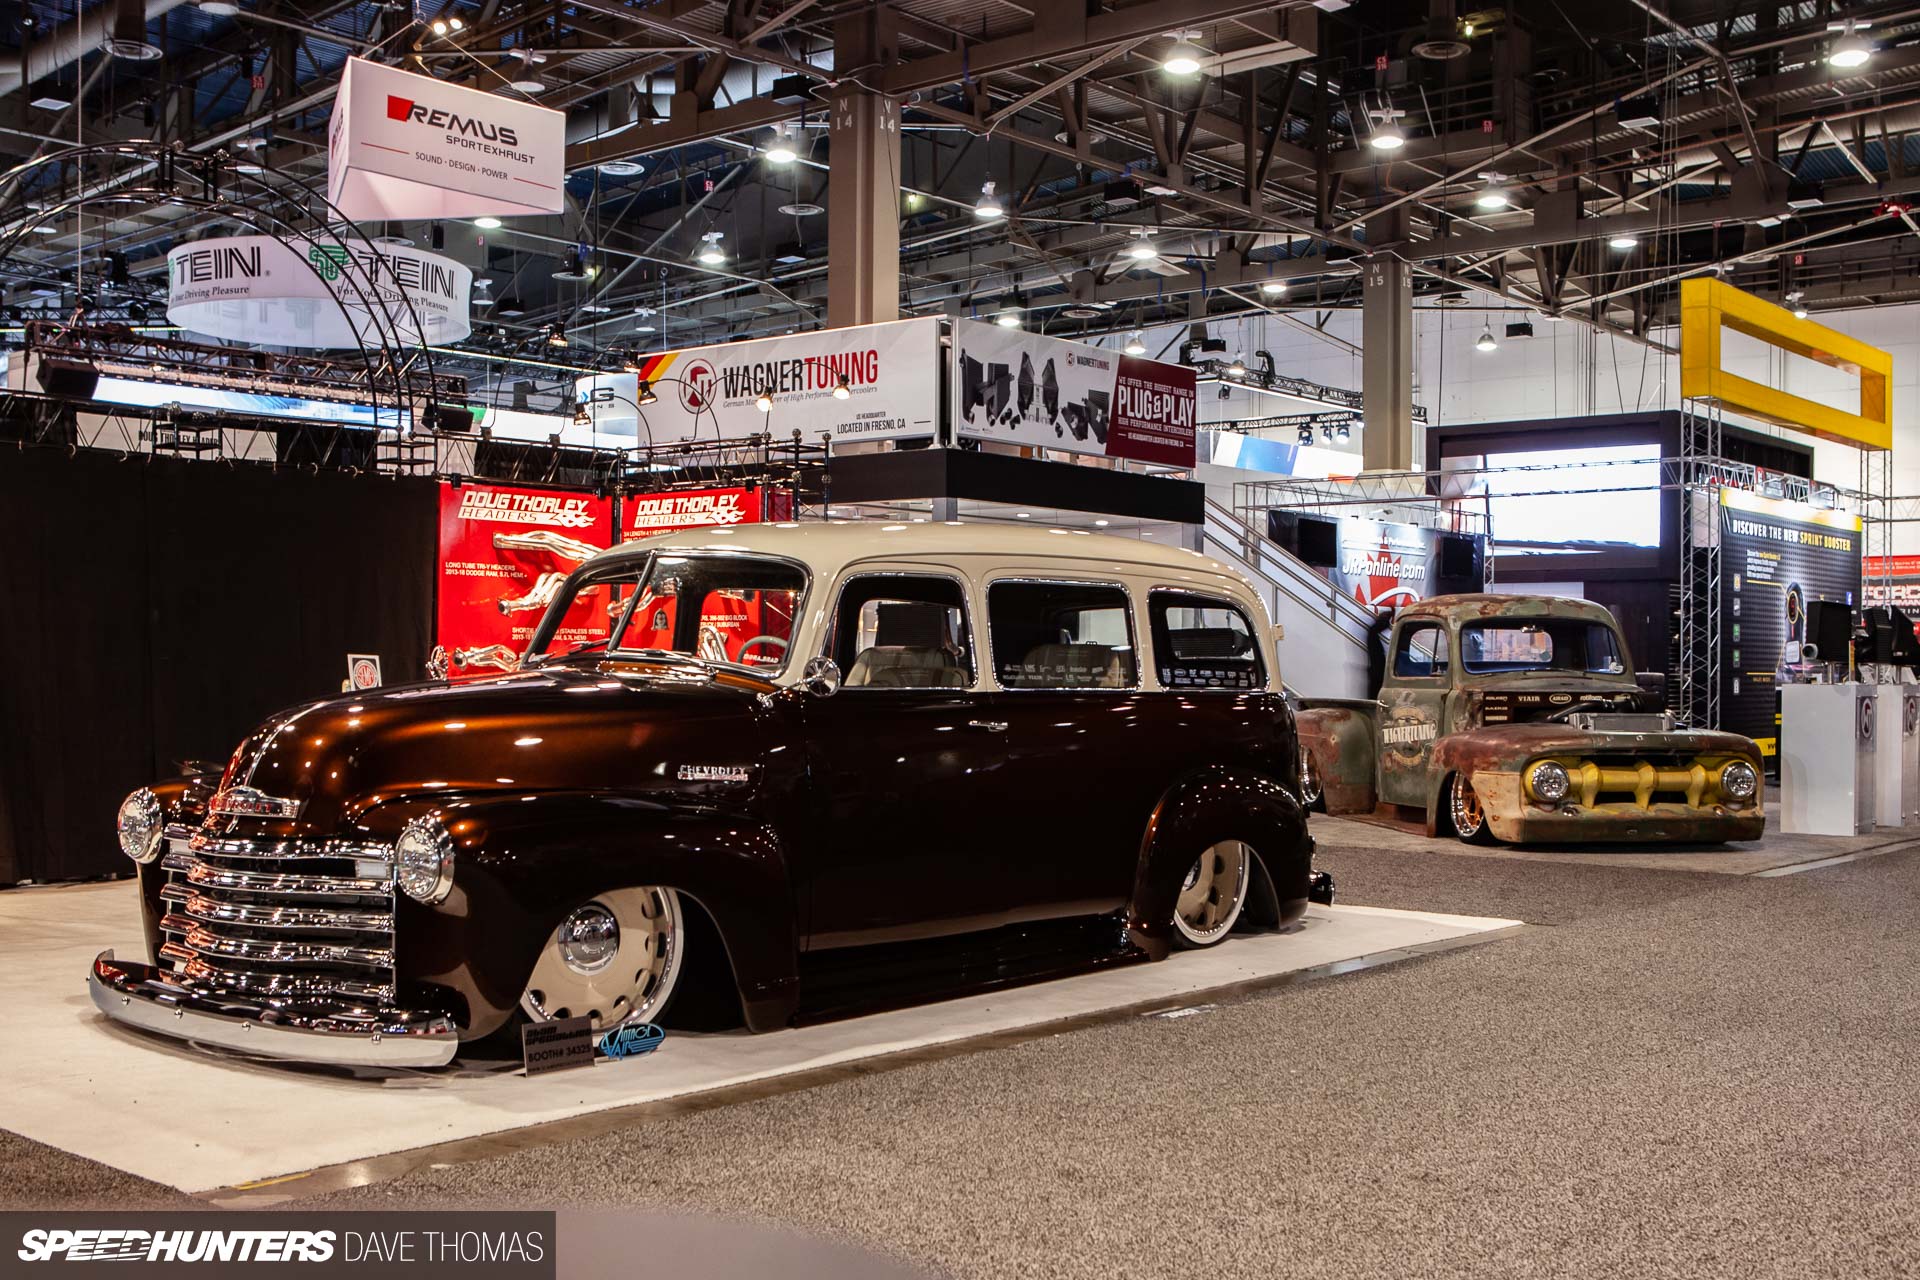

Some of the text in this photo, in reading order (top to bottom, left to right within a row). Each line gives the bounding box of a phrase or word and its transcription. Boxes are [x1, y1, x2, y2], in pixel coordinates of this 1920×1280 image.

[839, 98, 848, 112] N
[883, 99, 891, 113] N
[405, 103, 518, 147] REMUS
[836, 114, 853, 130] 14
[880, 116, 895, 132] 14
[446, 135, 535, 165] SPORTEXHAUST
[415, 151, 508, 180] SOUND DESIGN POWER
[176, 246, 261, 286] TEIN
[1372, 263, 1380, 273] N
[358, 250, 455, 300] TEIN
[1370, 276, 1384, 287] 15
[1402, 277, 1411, 288] 15
[212, 286, 250, 296] Pleasure
[420, 297, 449, 312] Pleasure
[1127, 377, 1142, 387] OFFER
[1143, 381, 1153, 390] THE
[723, 400, 745, 409] German
[790, 393, 804, 402] High
[837, 422, 863, 434] LOCATED
[864, 421, 870, 432] IN
[897, 418, 906, 429] CA
[1130, 419, 1162, 432] PERFORMANCE
[462, 490, 590, 513] DOUG THORLEY
[637, 494, 740, 516] DOUG THORLEY
[462, 508, 537, 522] HEADERS
[636, 513, 696, 526] HEADERS
[1732, 519, 1851, 552] DISCOVER THE NEW SPRINT BOOSTER
[462, 562, 476, 570] TUBE
[1342, 557, 1425, 580] JRPonline.com
[528, 1048, 564, 1062] BOOTH#
